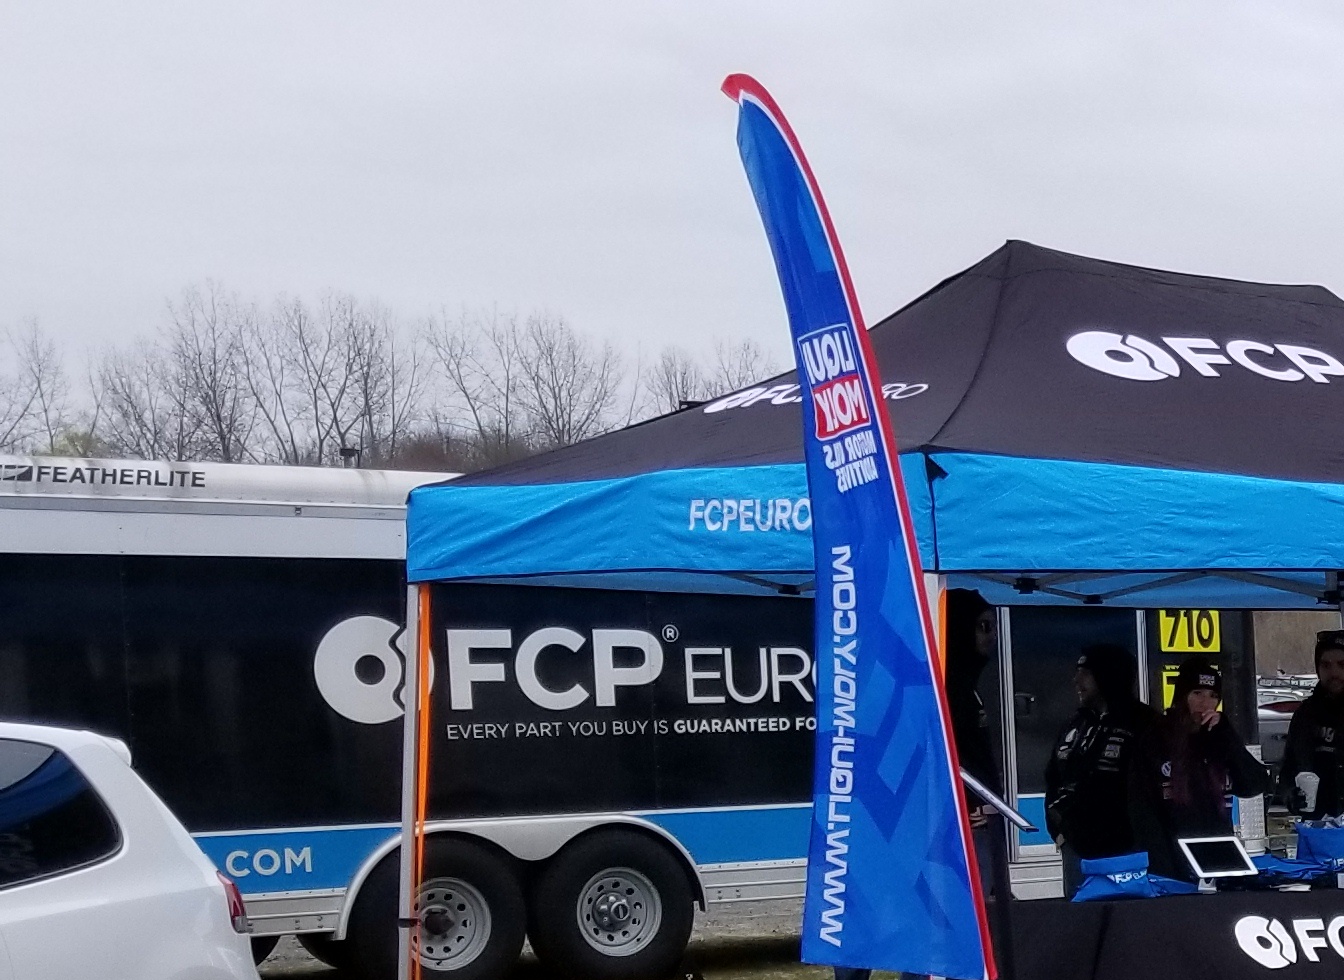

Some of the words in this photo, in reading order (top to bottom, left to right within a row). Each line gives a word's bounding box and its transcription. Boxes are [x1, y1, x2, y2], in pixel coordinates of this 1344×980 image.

[36, 465, 206, 488] FEATHERLITE
[688, 498, 811, 533] FCPEURO
[1164, 610, 1216, 649] 710
[446, 627, 664, 711] FCP
[684, 646, 818, 705] EUR
[446, 723, 510, 740] EVERY
[515, 721, 563, 738] PART
[567, 720, 607, 737] YOU
[612, 720, 649, 736] BUY
[653, 719, 669, 735] IS
[673, 716, 791, 735] GUARANTEED
[795, 717, 818, 731] FO
[225, 846, 313, 878] COM
